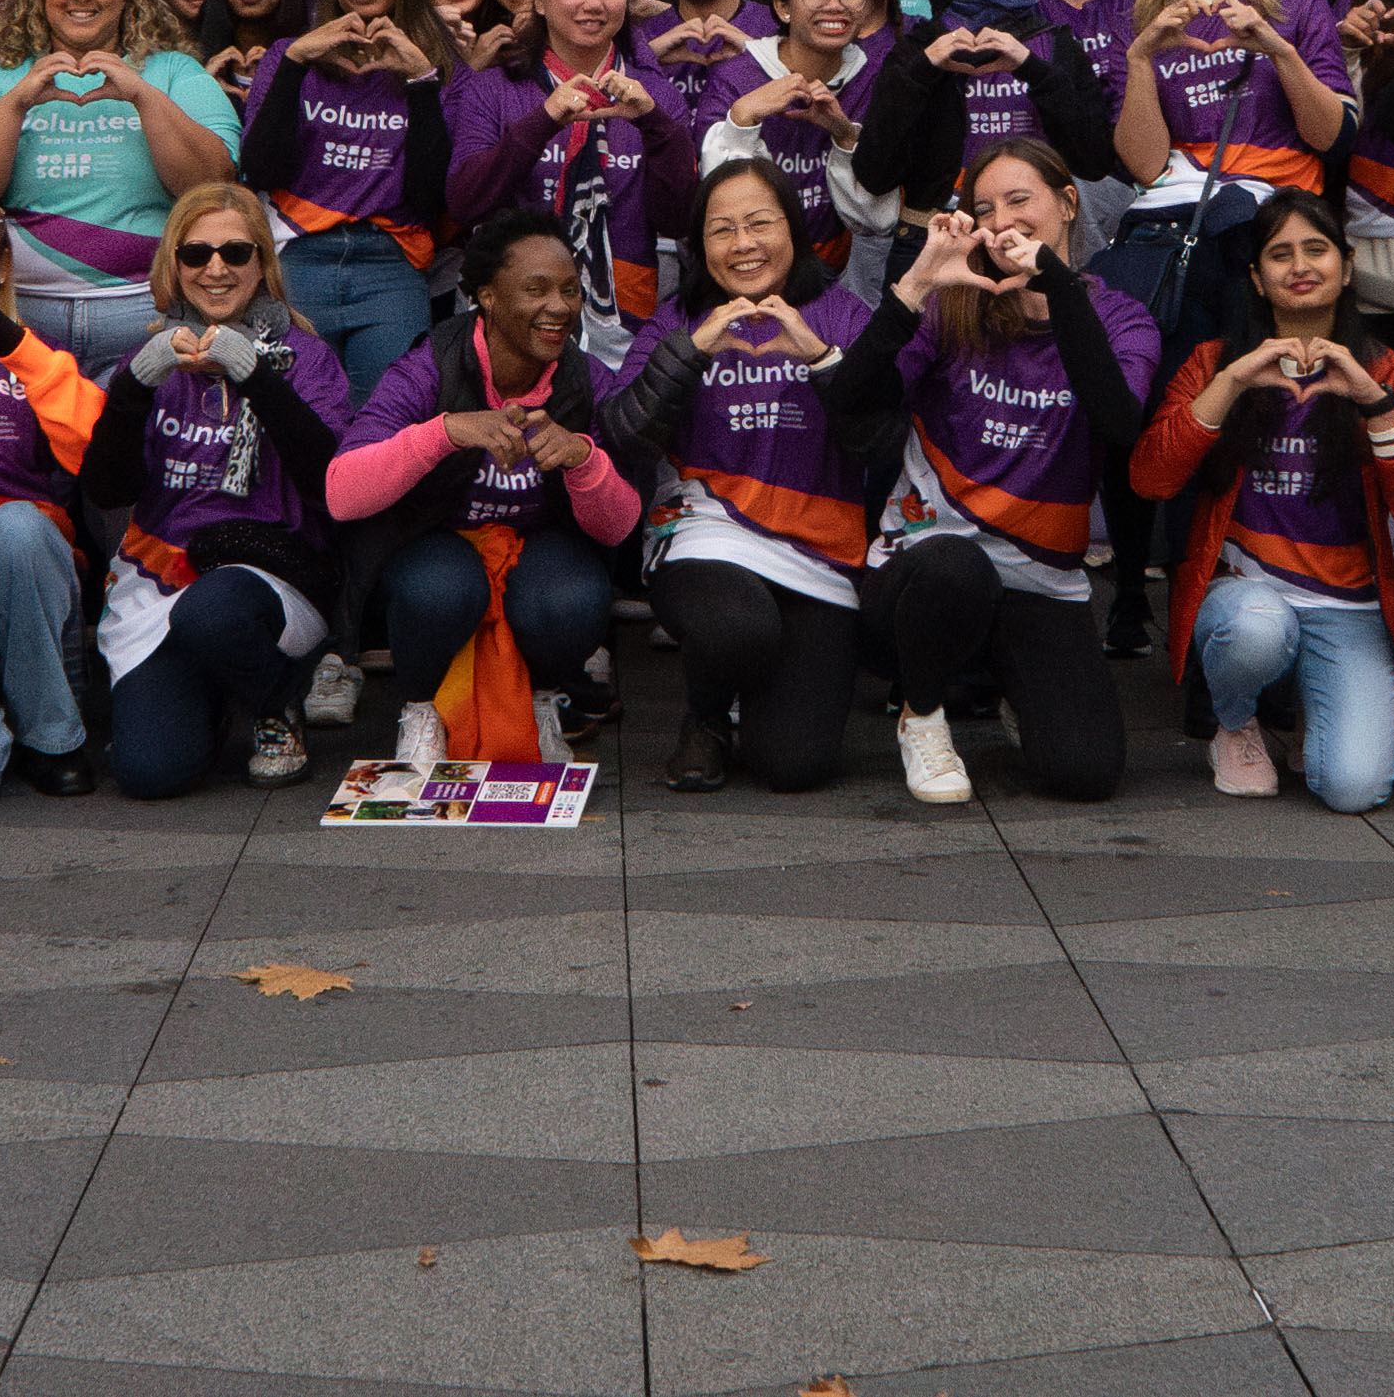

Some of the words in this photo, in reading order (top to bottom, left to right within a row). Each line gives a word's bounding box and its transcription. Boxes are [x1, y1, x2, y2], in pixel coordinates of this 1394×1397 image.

[1159, 47, 1268, 80] Volunte
[21, 112, 142, 133] Voluntee
[303, 100, 409, 130] Volunte
[970, 121, 1012, 135] SCHF
[39, 134, 74, 145] Team
[77, 134, 125, 144] Leader
[322, 153, 371, 170] SCHF
[36, 165, 91, 179] SCHF
[702, 360, 810, 387] Volunte
[729, 415, 779, 432] SCHF
[1252, 481, 1303, 496] SCHF
